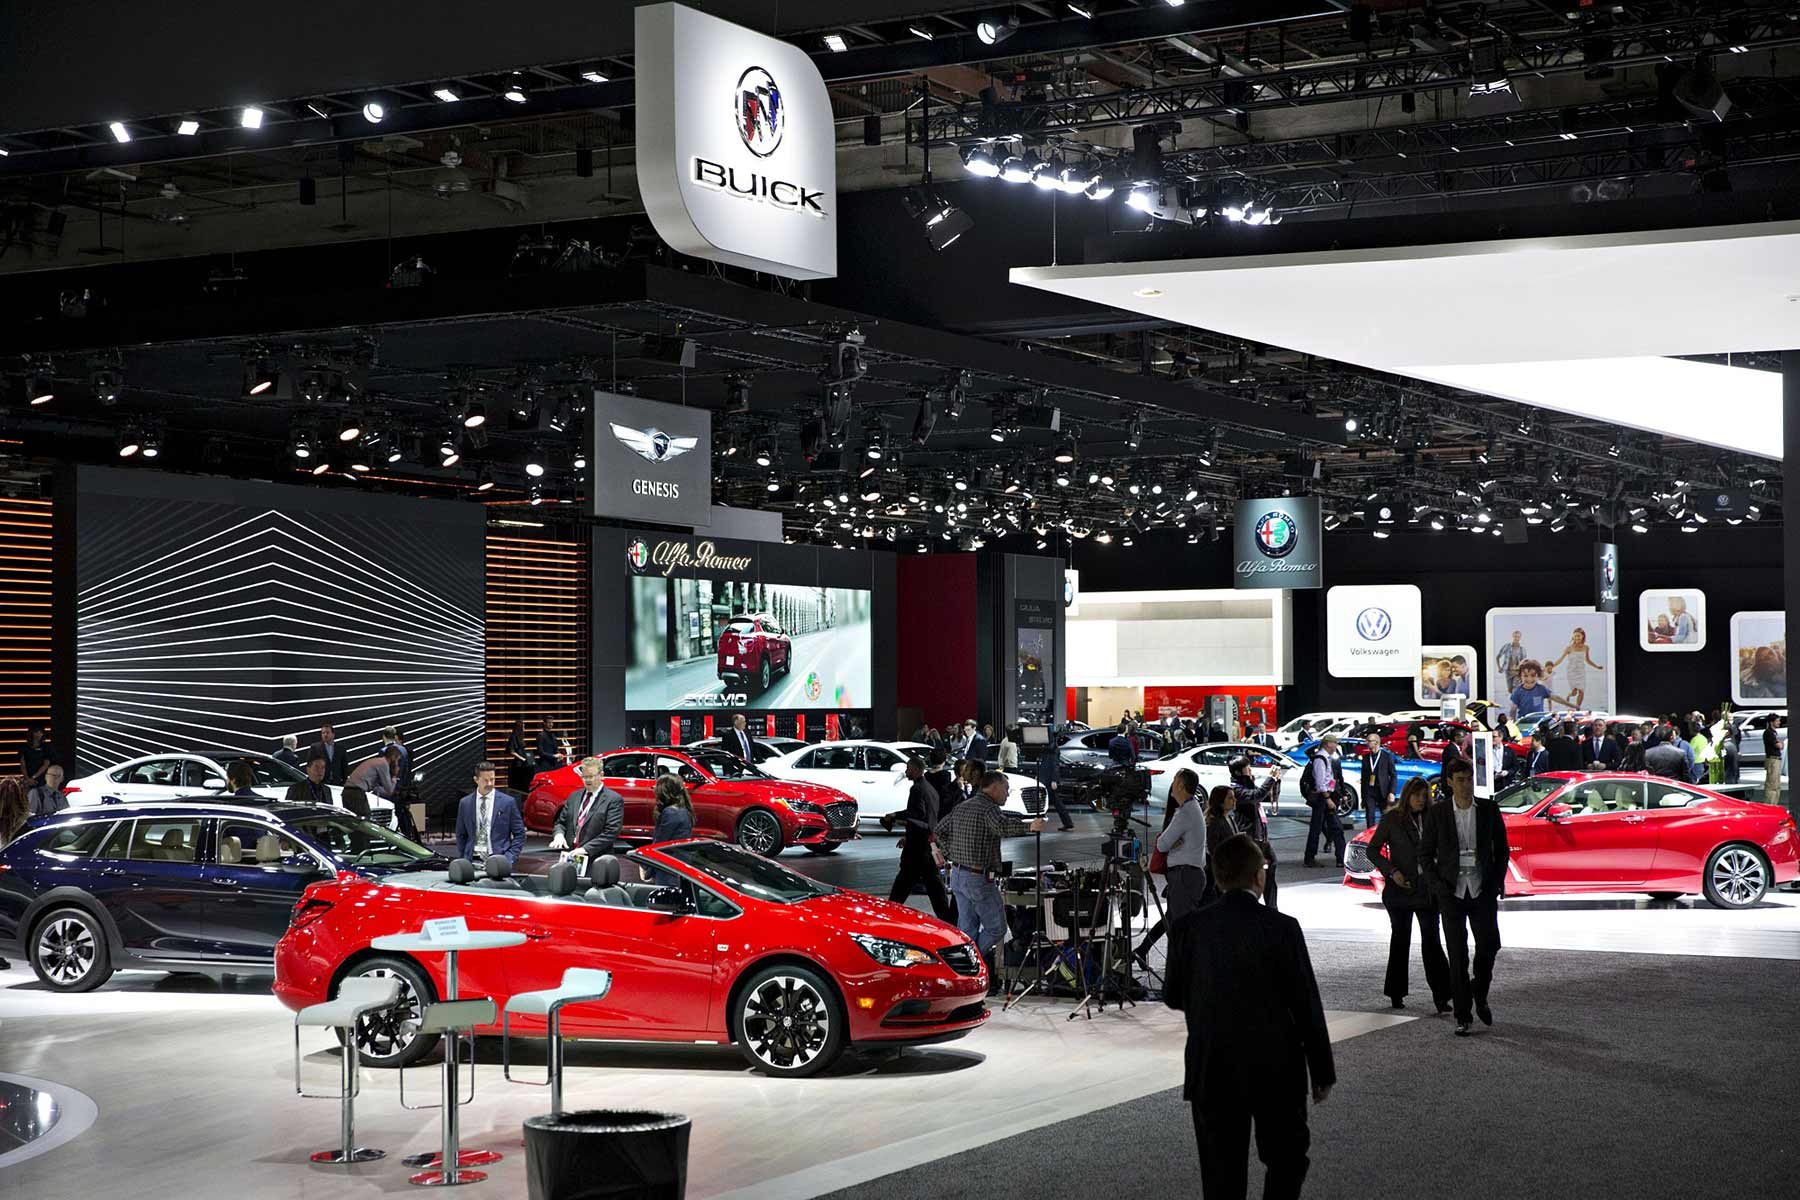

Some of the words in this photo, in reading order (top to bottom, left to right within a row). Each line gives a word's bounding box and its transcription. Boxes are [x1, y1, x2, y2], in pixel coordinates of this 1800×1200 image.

[695, 157, 826, 213] BUICK
[632, 479, 679, 499] GENESIS
[652, 540, 691, 577] Alfa
[690, 541, 752, 571] Romeo
[1236, 560, 1269, 578] Alfa
[1269, 559, 1318, 572] Romeo
[1349, 648, 1400, 656] Volkswagen
[683, 693, 748, 707] STELVIO
